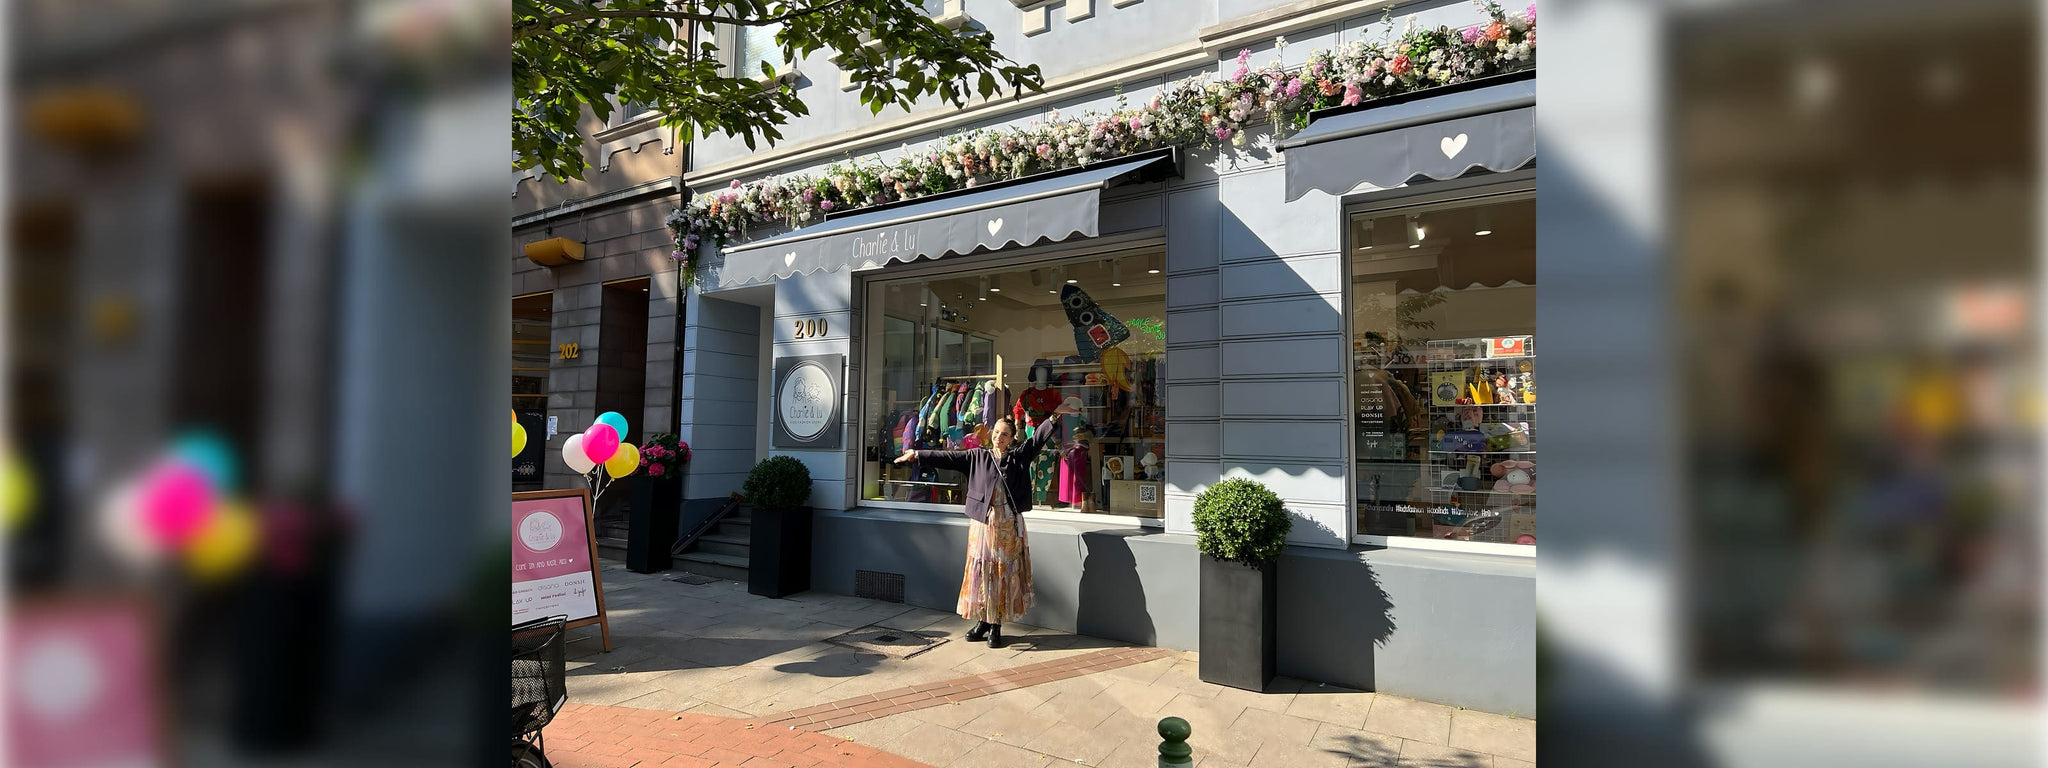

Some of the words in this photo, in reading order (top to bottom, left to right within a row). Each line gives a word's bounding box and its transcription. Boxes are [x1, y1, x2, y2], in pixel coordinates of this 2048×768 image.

[852, 231, 888, 258] Charlie
[890, 230, 899, 253] &
[904, 228, 916, 251] Lu
[794, 317, 828, 339] 200
[558, 343, 579, 359] 202
